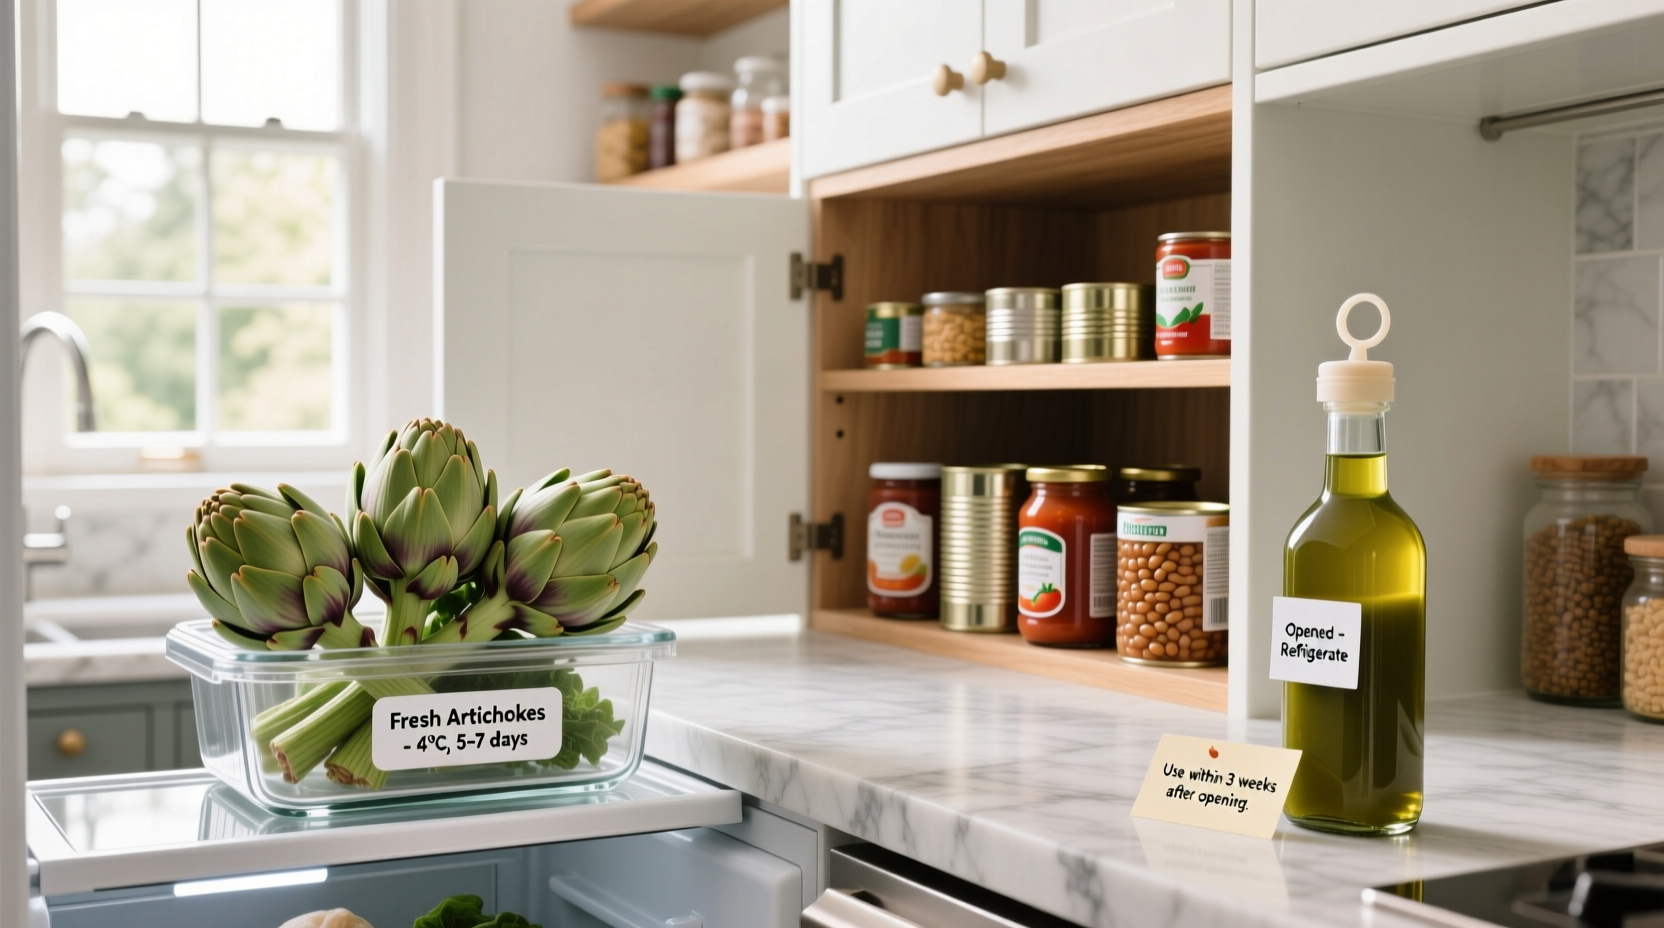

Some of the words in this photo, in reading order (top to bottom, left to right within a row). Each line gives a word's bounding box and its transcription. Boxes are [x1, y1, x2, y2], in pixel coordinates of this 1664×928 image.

[1285, 622, 1334, 642] Opened
[390, 709, 441, 730] Fresh
[446, 703, 546, 726] Artichokes
[489, 730, 528, 751] days
[1163, 762, 1185, 779] Use
[1189, 767, 1223, 785] within
[1225, 772, 1235, 786] 3
[1238, 776, 1277, 793] weeks
[1166, 784, 1195, 801] after
